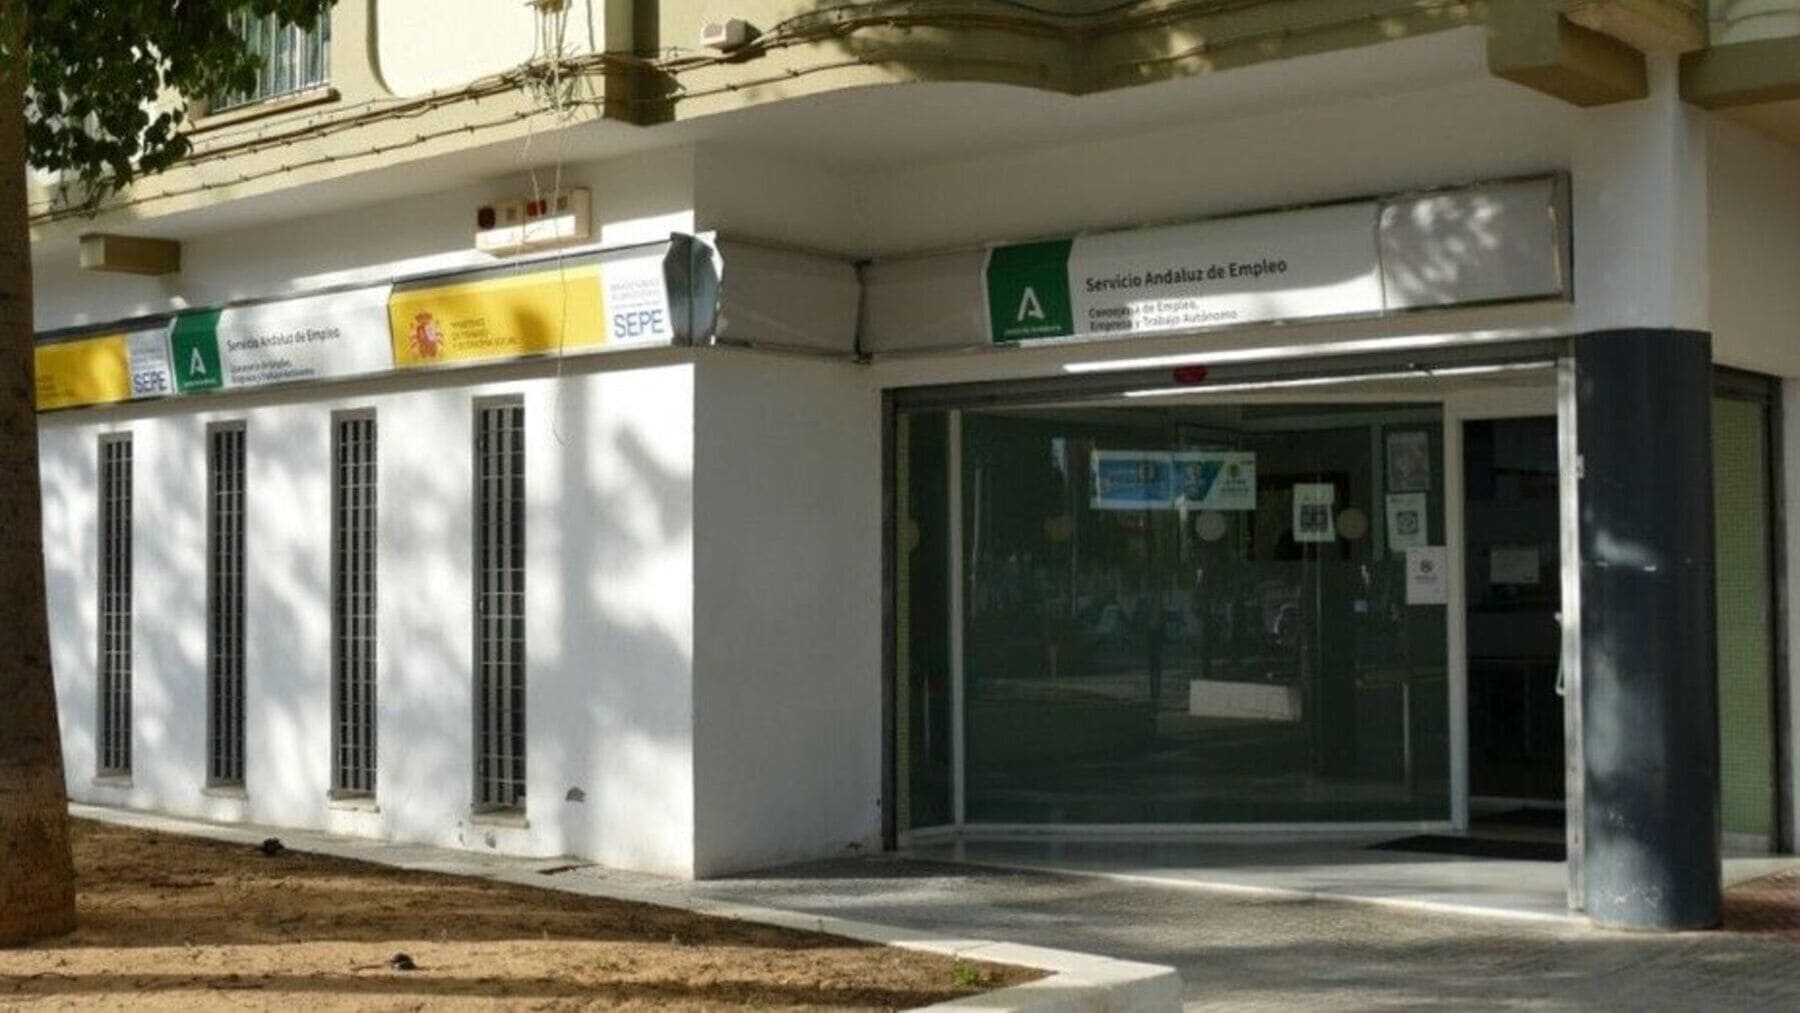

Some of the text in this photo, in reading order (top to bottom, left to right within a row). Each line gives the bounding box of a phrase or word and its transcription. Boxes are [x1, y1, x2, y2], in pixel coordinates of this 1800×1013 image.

[1086, 258, 1287, 293] Servicio Andaluz de Empleo
[614, 309, 665, 338] SEPE
[133, 370, 168, 393] SEPE
